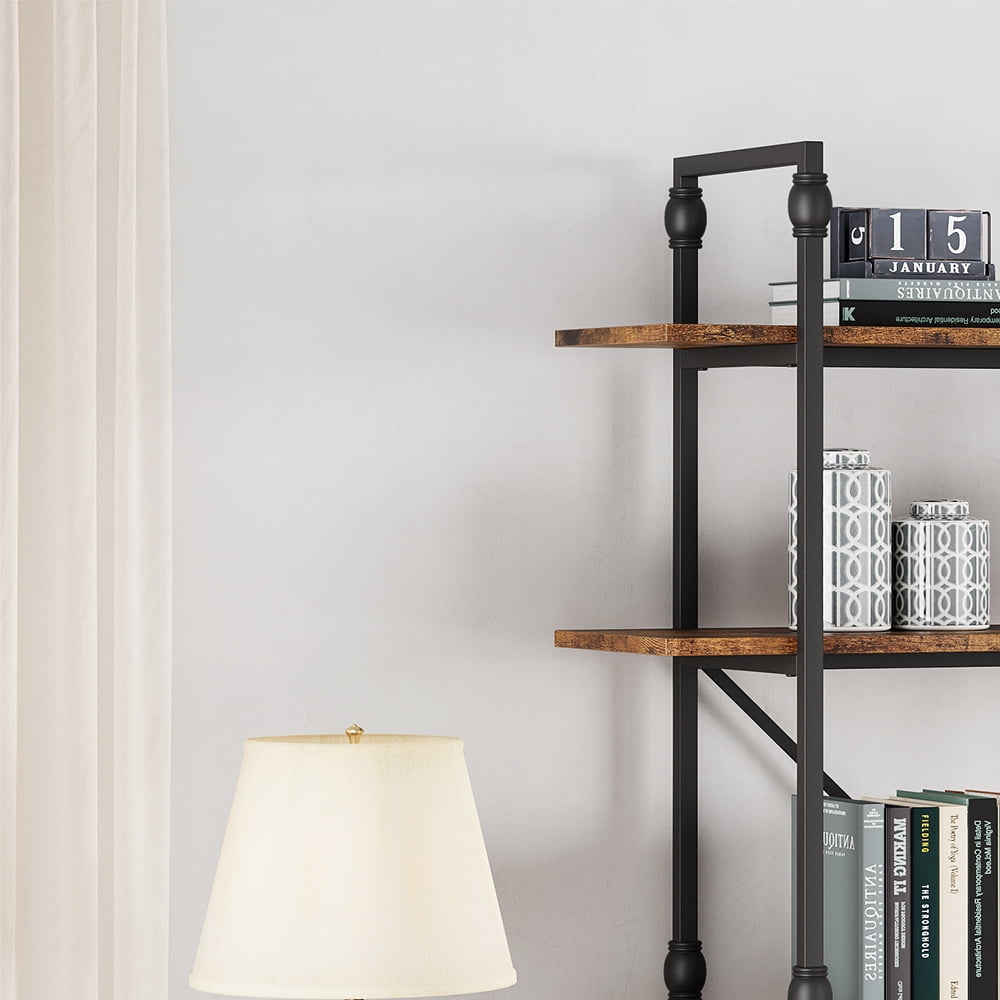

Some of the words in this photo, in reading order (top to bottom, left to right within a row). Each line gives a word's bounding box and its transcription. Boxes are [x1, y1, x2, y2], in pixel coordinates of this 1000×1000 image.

[889, 212, 904, 251] 1
[947, 215, 967, 254] 5
[889, 262, 971, 274] JANUARY
[896, 316, 932, 324] Architecture
[934, 316, 968, 324] Residential
[950, 814, 958, 824] The
[922, 814, 930, 853] FIELDING
[922, 884, 930, 902] THE
[921, 903, 930, 959] STRONGHOLD
